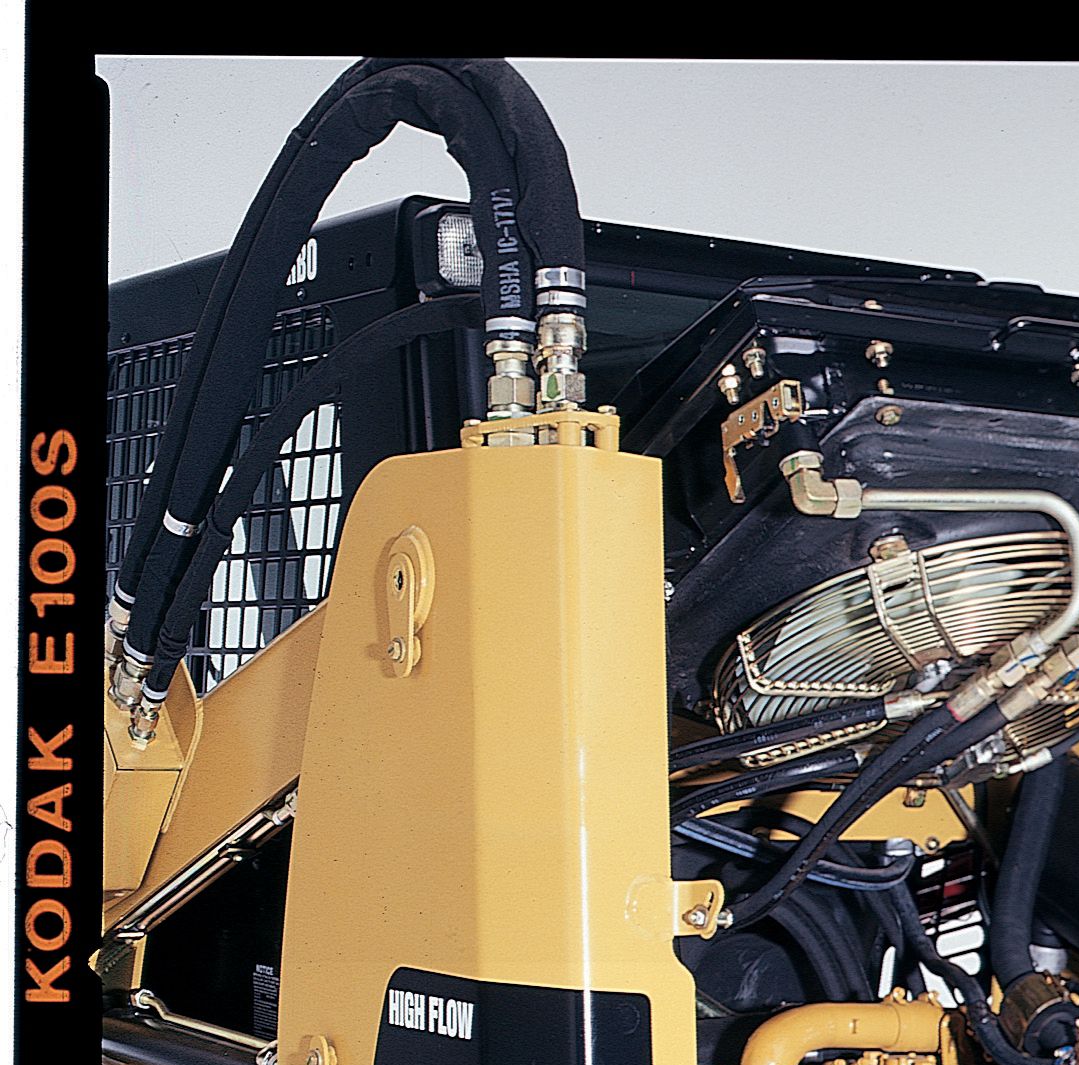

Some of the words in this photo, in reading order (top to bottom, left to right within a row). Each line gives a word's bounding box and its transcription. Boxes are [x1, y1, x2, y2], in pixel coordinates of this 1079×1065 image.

[499, 261, 522, 309] MSHA
[29, 430, 77, 674] E100S
[26, 724, 74, 1003] KODAK
[388, 989, 426, 1031] HIGH
[428, 996, 475, 1040] FLOW
